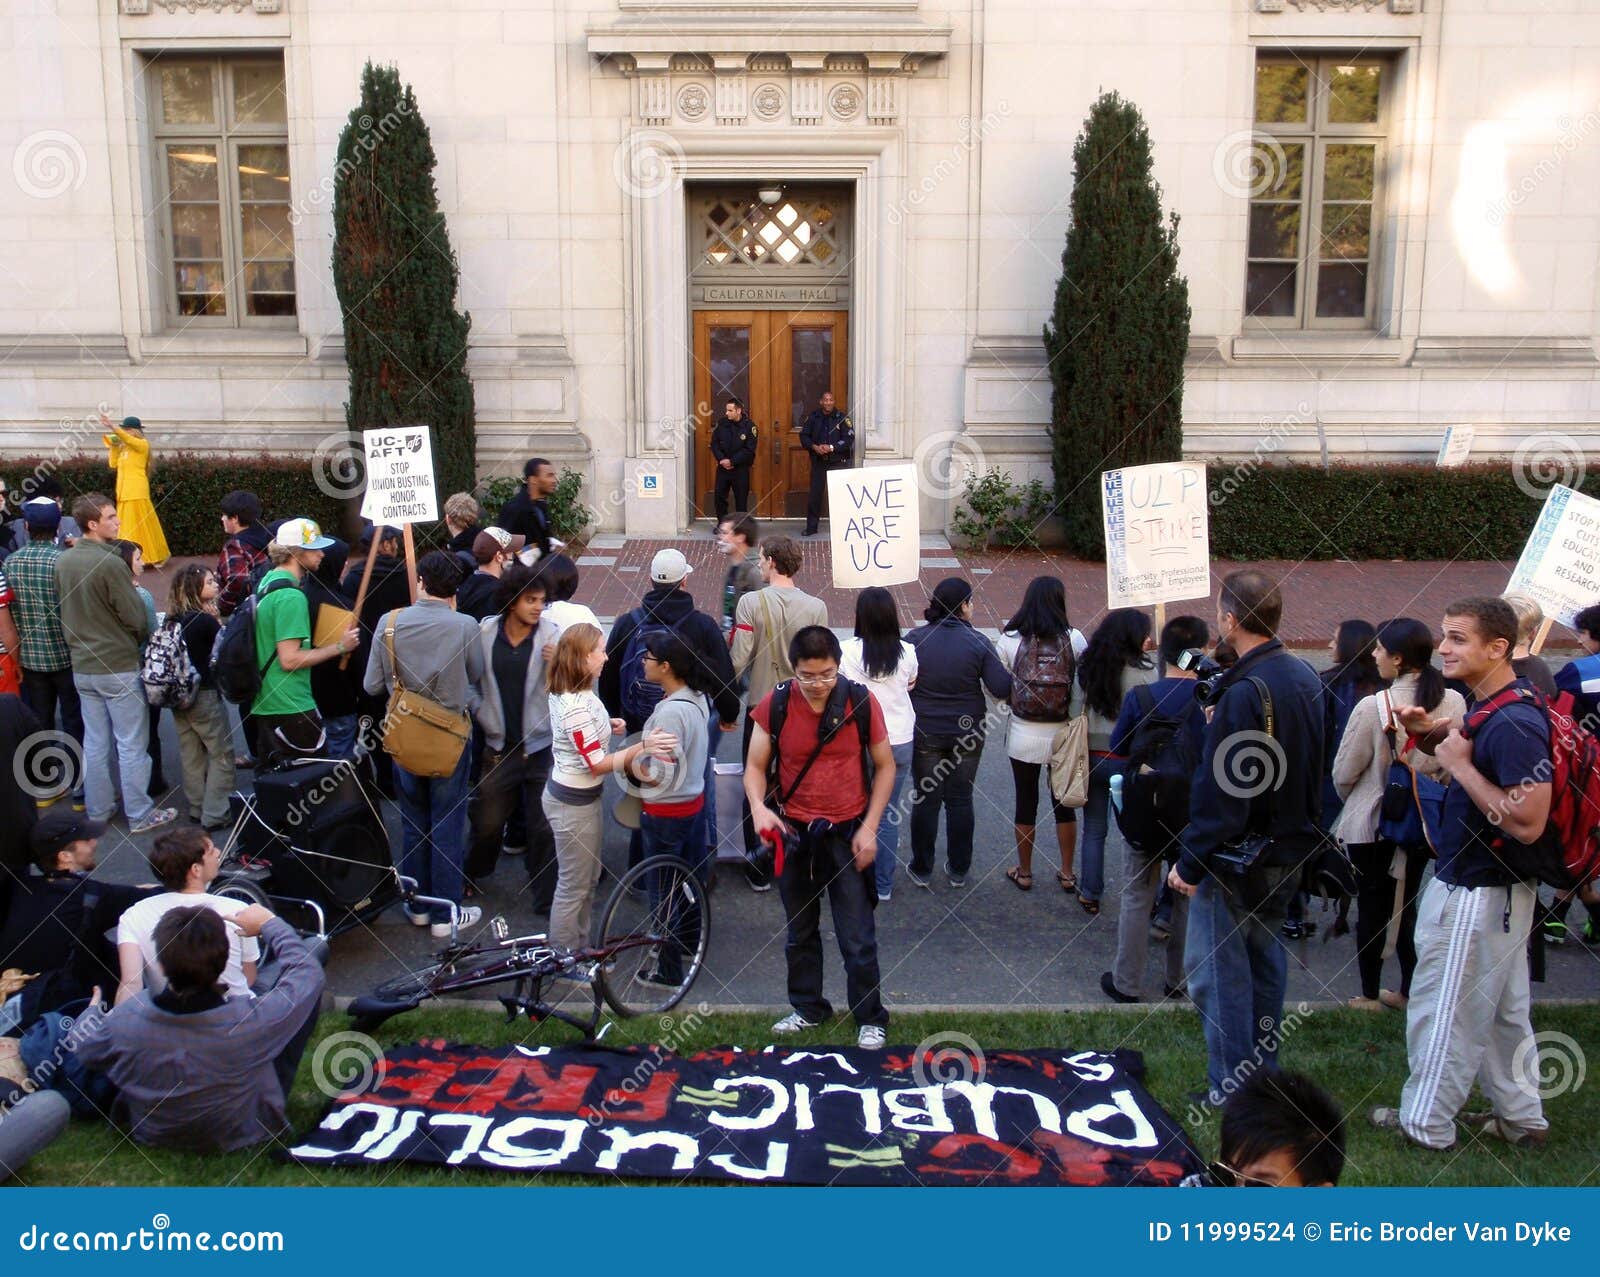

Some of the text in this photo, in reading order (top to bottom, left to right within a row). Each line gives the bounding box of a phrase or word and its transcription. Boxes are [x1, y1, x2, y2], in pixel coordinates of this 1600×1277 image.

[709, 288, 831, 300] CALIFORNIA HALL
[371, 436, 402, 447] UC-
[370, 447, 405, 459] AFT
[390, 462, 410, 475] STOP
[372, 478, 396, 491] UNION
[390, 490, 417, 504] HONOR
[846, 478, 905, 509] WE
[383, 503, 427, 518] CONTRACTS
[1568, 511, 1594, 527] STOP
[844, 515, 901, 542] ARE
[1128, 516, 1203, 545] STRIKE
[850, 539, 894, 572] UC
[1562, 538, 1600, 562] EDUCAT
[1573, 559, 1595, 575] AND
[1555, 565, 1600, 593] RESEARCH
[708, 1075, 1159, 1148] PUBLIC
